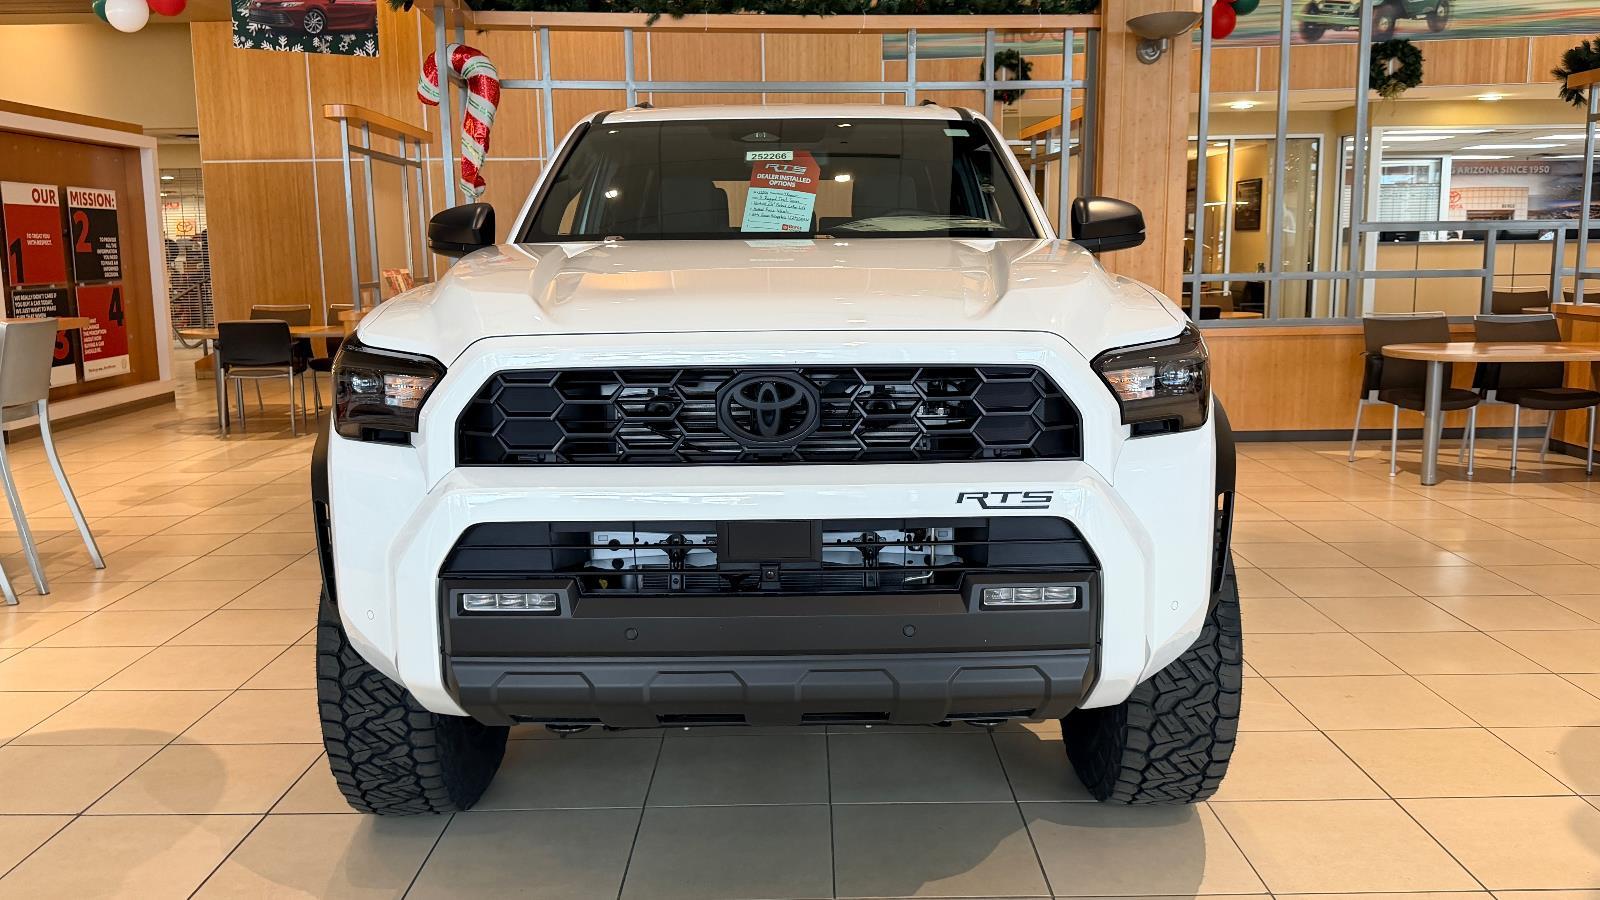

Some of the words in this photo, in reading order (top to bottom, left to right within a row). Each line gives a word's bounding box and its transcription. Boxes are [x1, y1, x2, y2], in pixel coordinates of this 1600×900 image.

[765, 163, 807, 174] RTS
[780, 175, 811, 184] INSTALLED
[32, 188, 56, 204] OUR
[70, 190, 115, 208] MISSION:
[73, 210, 92, 253] 2
[9, 238, 24, 283] 1
[108, 288, 124, 326] 4
[955, 491, 1054, 509] RTS
